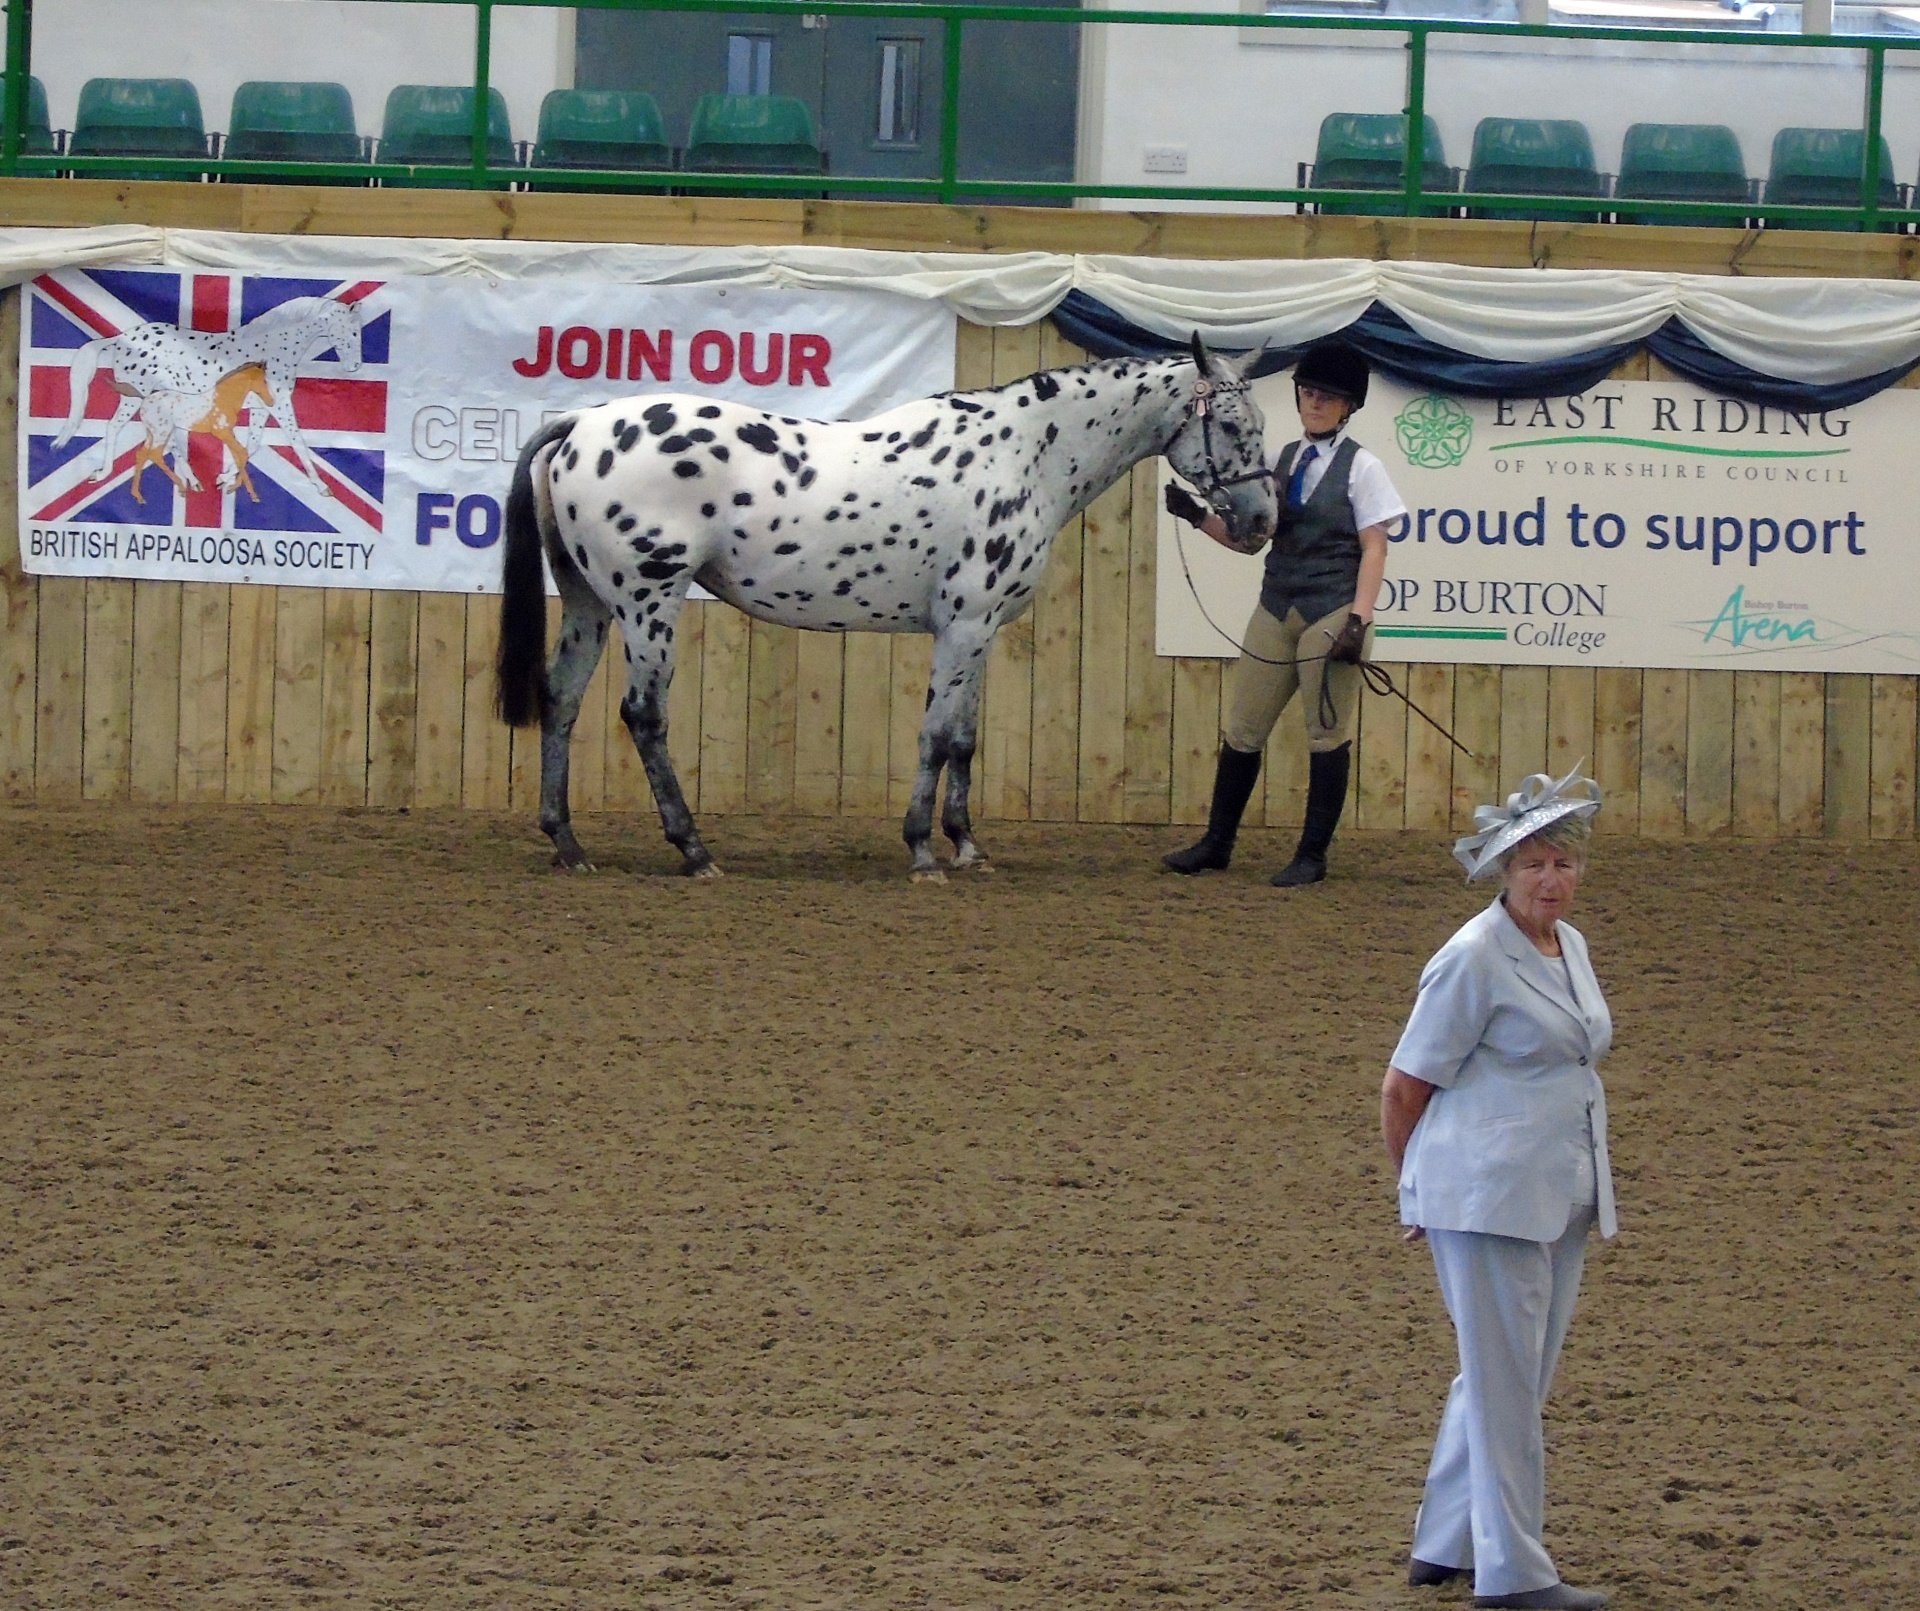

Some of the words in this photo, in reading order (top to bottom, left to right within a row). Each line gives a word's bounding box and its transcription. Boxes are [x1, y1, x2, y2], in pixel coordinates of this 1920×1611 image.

[512, 325, 672, 382] JOIN
[689, 330, 832, 387] OUR
[1493, 395, 1623, 429] EAST
[1652, 397, 1851, 437] RIDING
[1494, 459, 1526, 474] OF
[1546, 460, 1706, 479] YORKSHIRE
[1727, 466, 1850, 483] COUNCIL
[31, 530, 119, 560] BRITISH
[126, 533, 267, 567] APPALOOSA
[274, 540, 374, 571] SOCIETY
[1566, 503, 1626, 549] to
[1645, 510, 1867, 567] support
[1433, 580, 1608, 617] BURTON
[1703, 584, 1822, 648] Arena
[1744, 600, 1775, 610] Bishop
[1514, 622, 1607, 654] College
